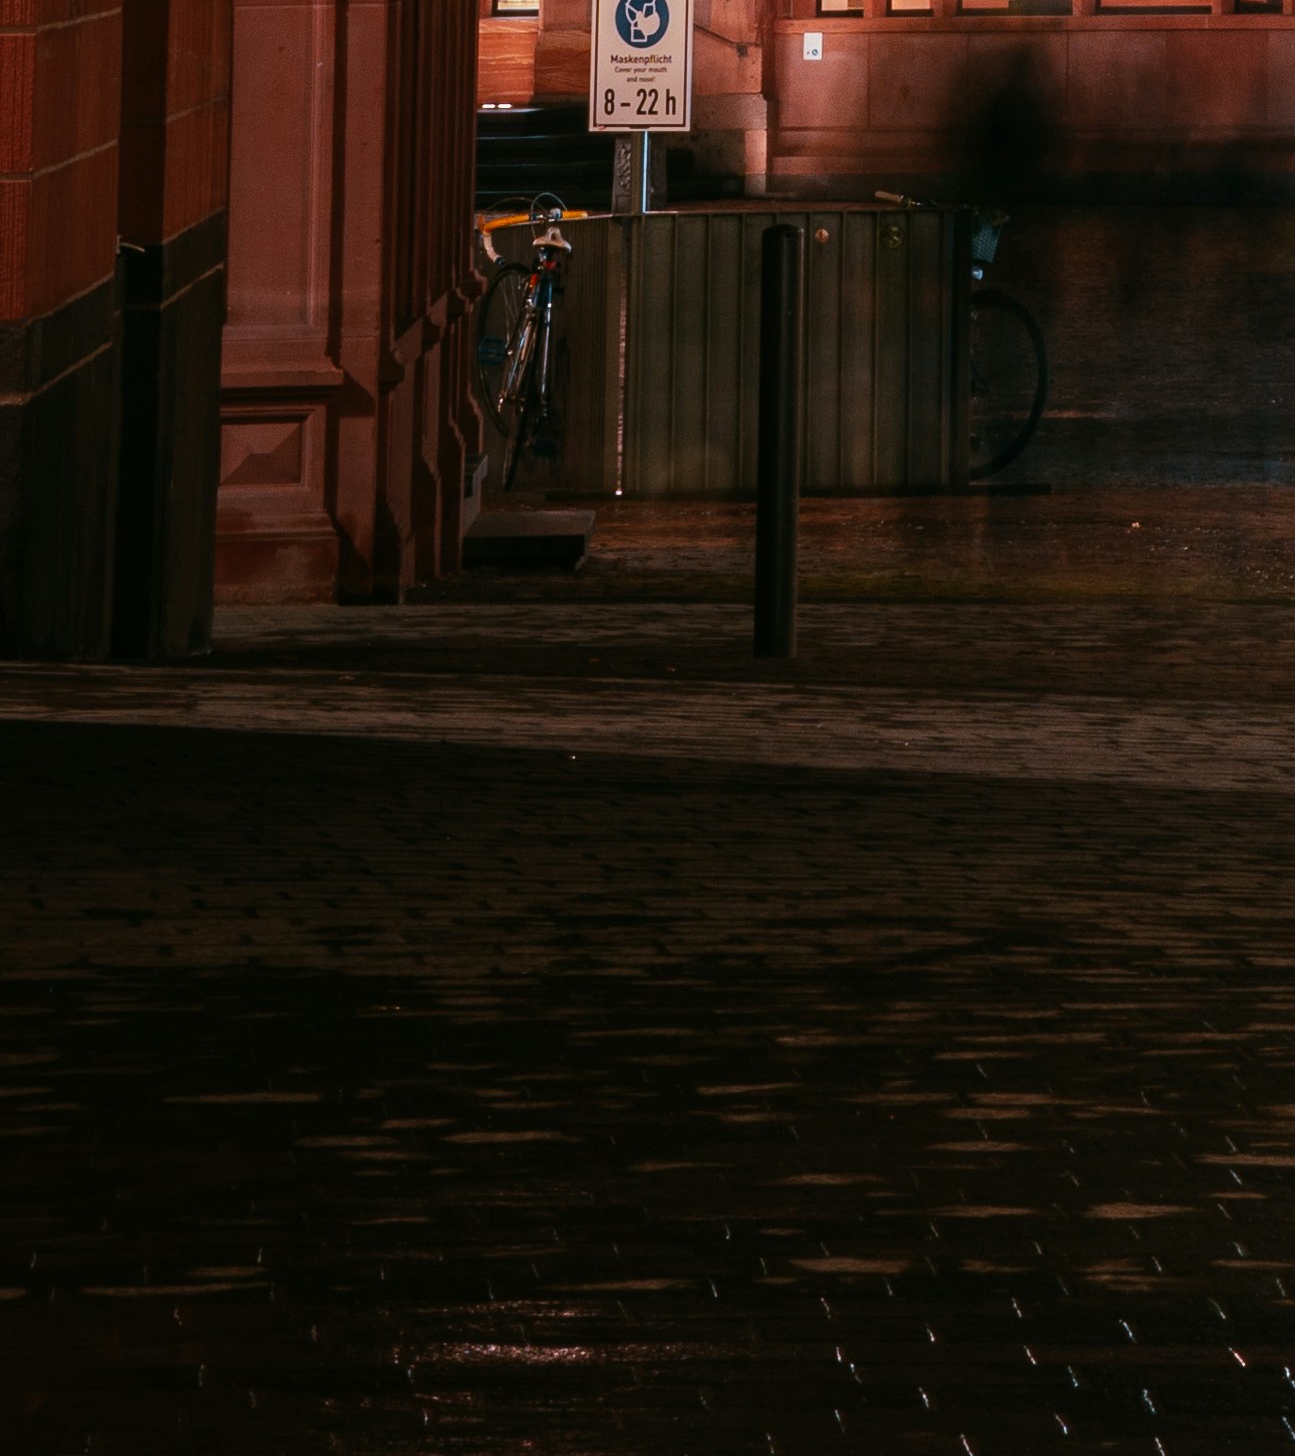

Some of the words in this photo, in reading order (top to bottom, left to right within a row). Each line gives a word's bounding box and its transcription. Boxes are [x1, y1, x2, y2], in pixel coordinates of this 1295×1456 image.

[610, 54, 672, 66] Maskenpflicht
[604, 88, 615, 116] 8
[635, 88, 659, 116] 22
[665, 88, 676, 116] h
